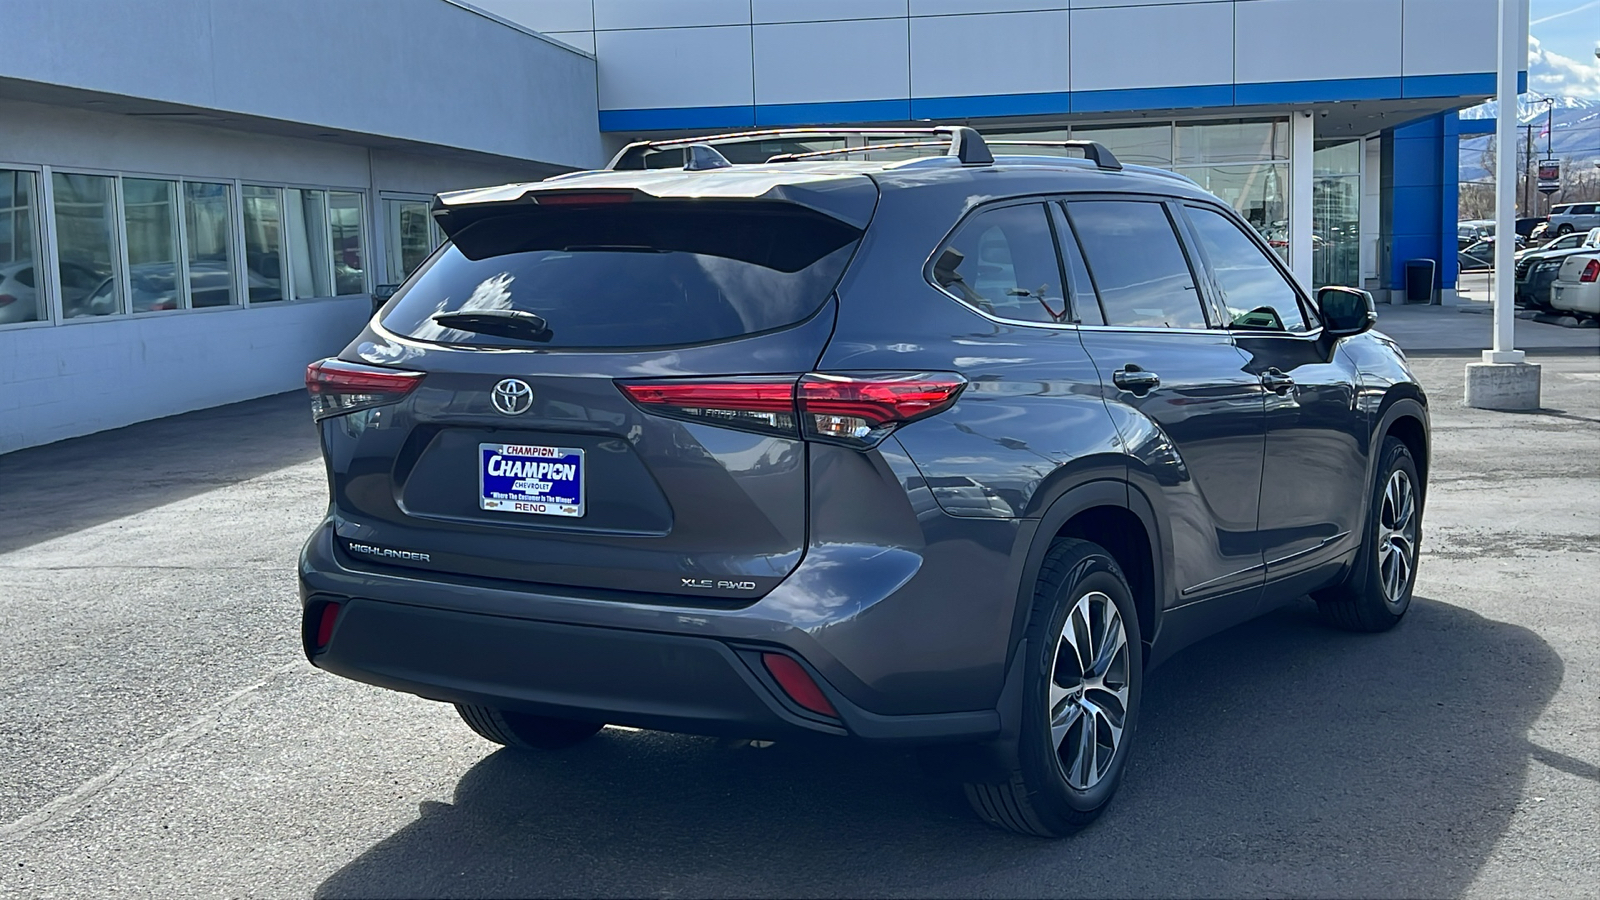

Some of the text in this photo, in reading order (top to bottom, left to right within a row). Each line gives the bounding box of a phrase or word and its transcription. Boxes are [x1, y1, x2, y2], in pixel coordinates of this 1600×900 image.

[507, 446, 555, 457] CHAMPION
[488, 455, 576, 481] CHAMPION
[515, 481, 550, 491] CHEVROLET
[515, 503, 547, 513] RENO
[349, 542, 430, 562] HIGHLANDER
[681, 578, 756, 590] XLE AWD
